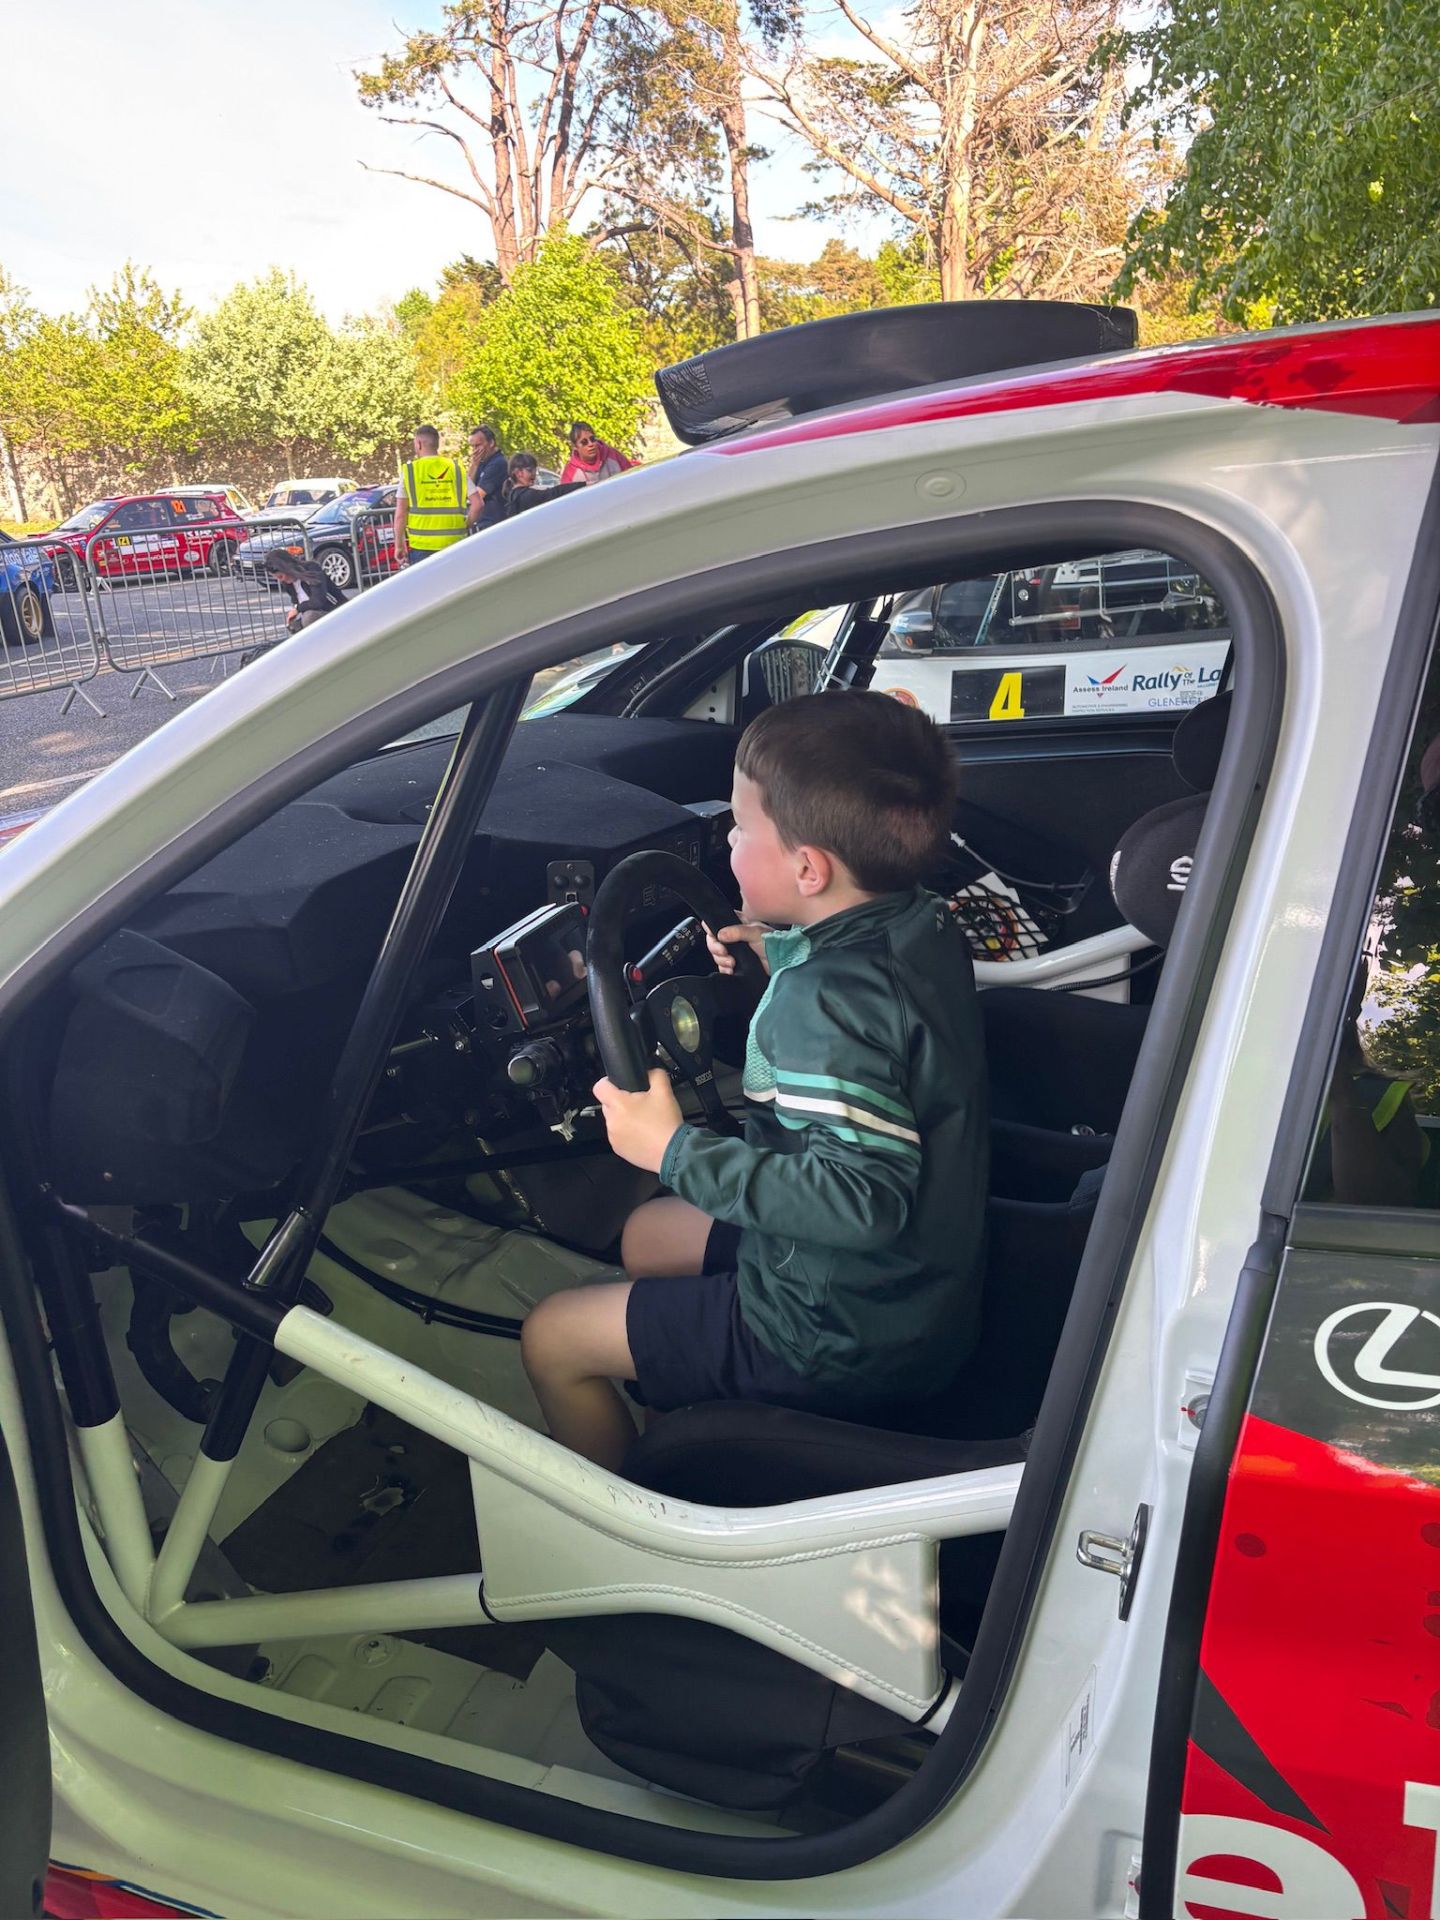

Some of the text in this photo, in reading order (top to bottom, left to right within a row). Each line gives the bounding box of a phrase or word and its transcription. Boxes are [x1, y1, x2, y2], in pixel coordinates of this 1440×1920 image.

[171, 500, 187, 514] 121
[1101, 684, 1128, 692] Ireland
[1132, 671, 1182, 691] Rally
[1198, 667, 1222, 683] La
[989, 672, 1024, 720] 4
